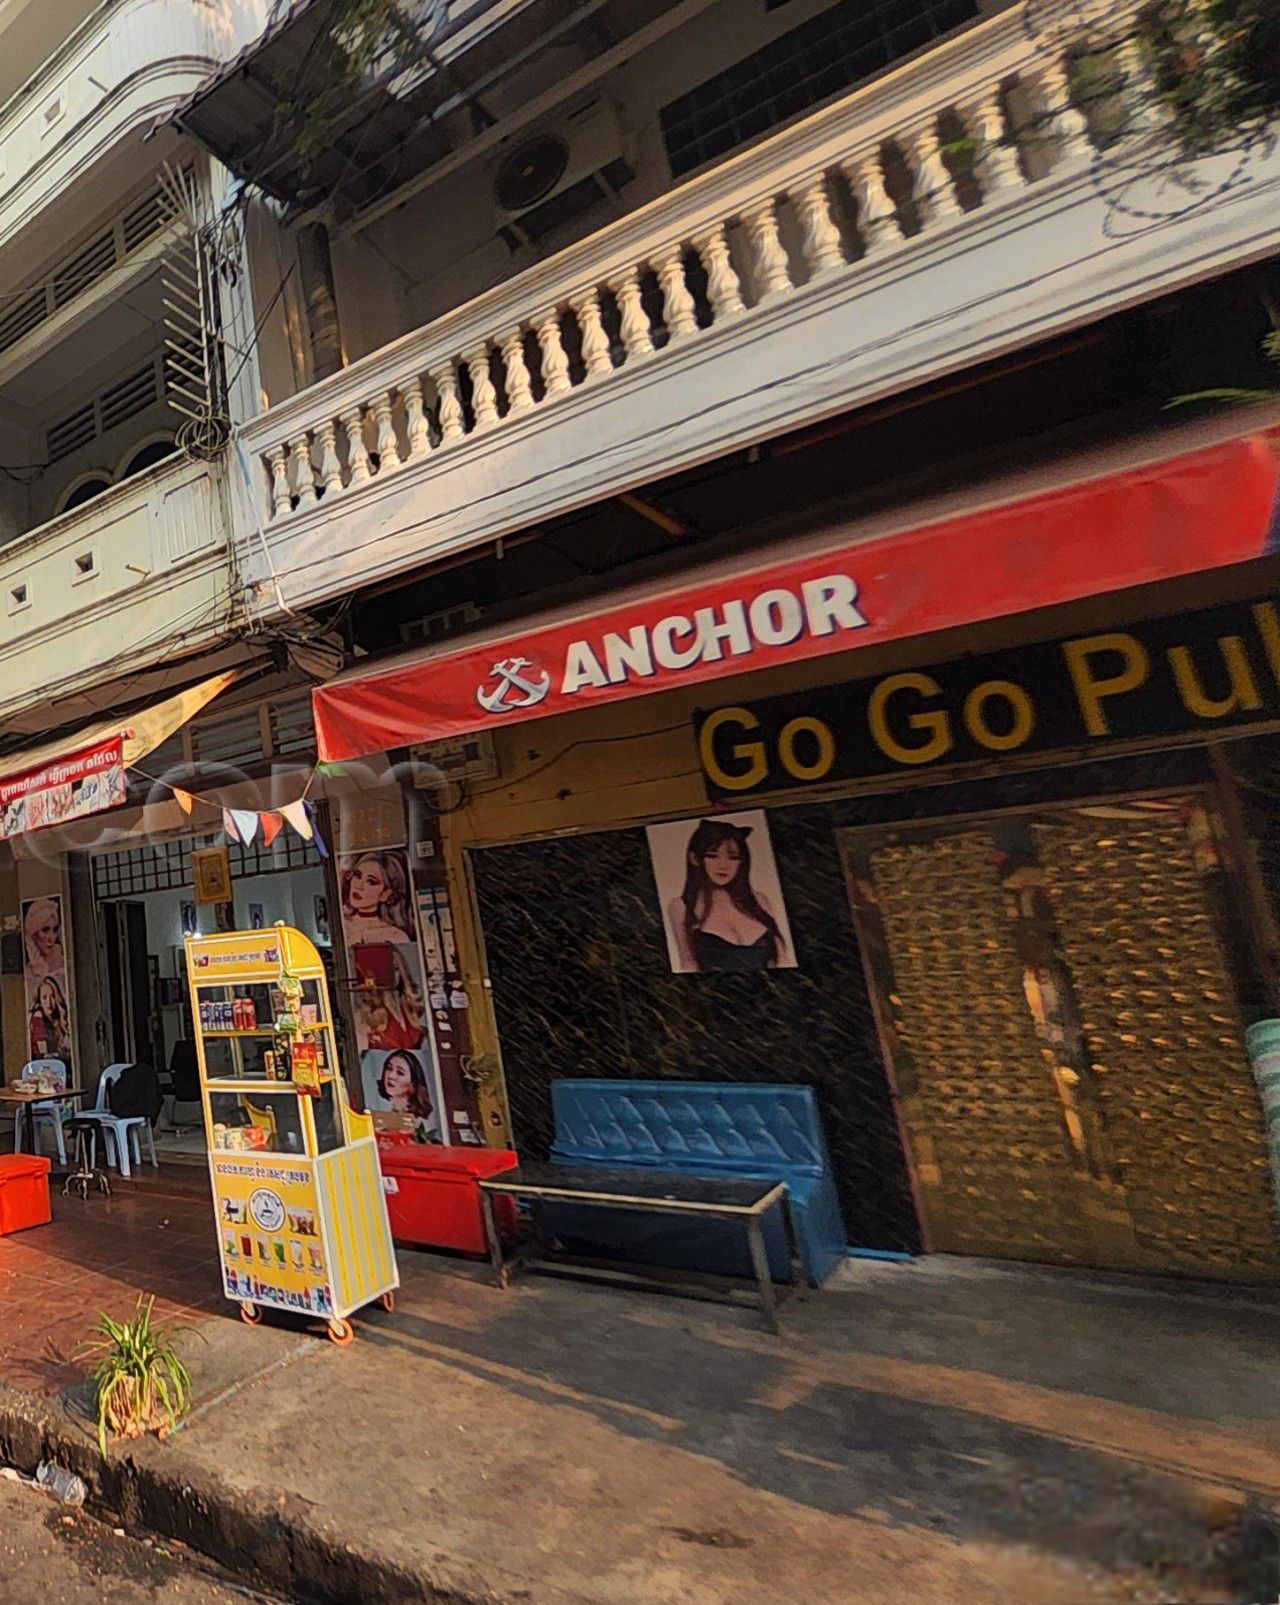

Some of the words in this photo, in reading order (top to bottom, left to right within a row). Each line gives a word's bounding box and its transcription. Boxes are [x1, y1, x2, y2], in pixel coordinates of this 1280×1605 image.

[561, 573, 868, 695] ANCHOR
[699, 706, 836, 791] Go
[868, 672, 1036, 764] Go
[1062, 600, 1280, 737] Pu
